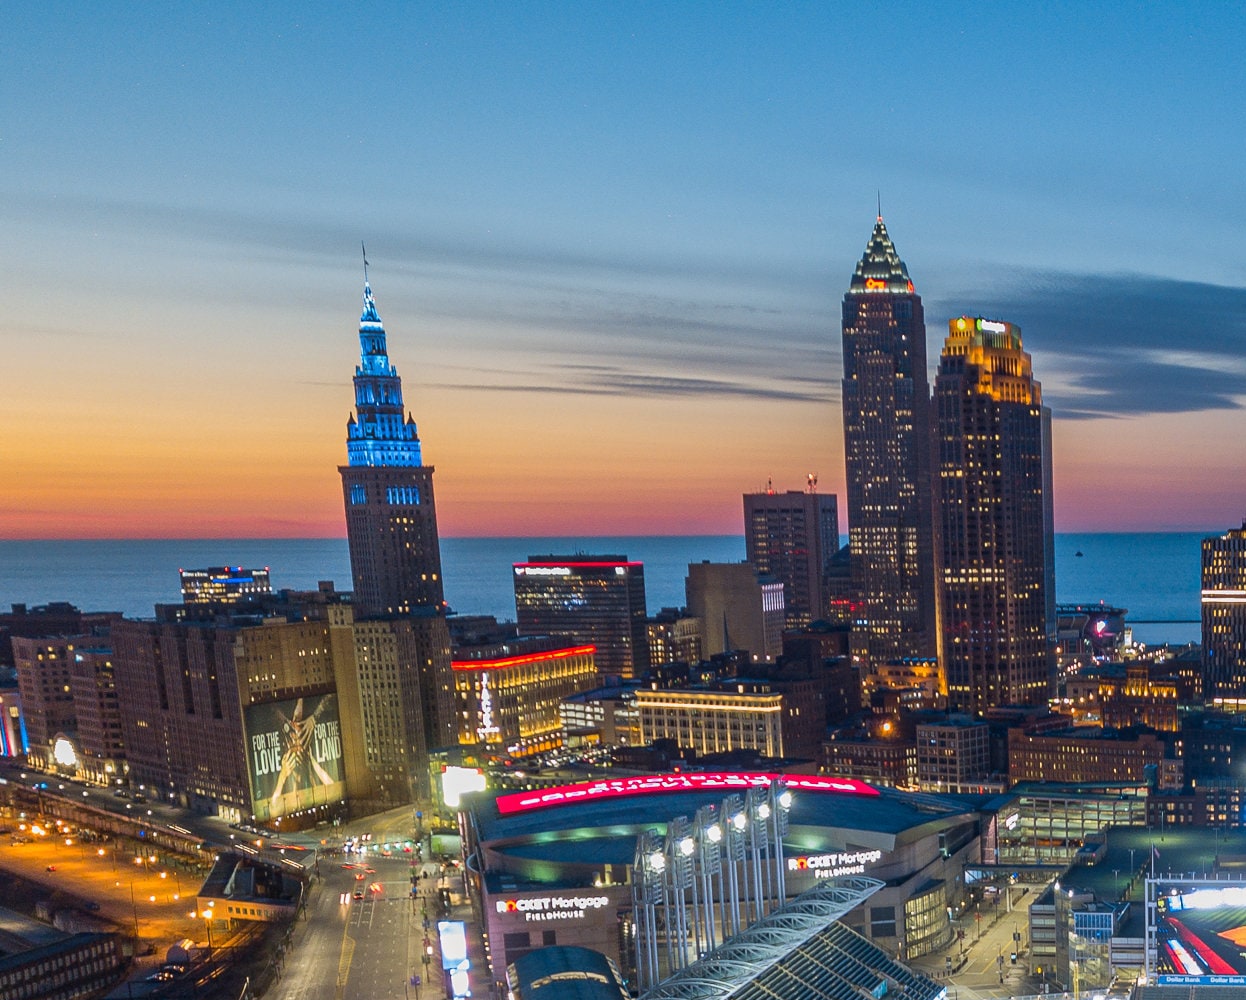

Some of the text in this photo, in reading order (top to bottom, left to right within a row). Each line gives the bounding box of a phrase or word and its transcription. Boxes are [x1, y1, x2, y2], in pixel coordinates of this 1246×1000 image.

[314, 721, 340, 740] FOR THE
[252, 731, 280, 751] FOR THE
[315, 736, 341, 763] LAND
[253, 746, 282, 776] LOVE
[788, 850, 881, 870] ROCKET Mortgage
[496, 896, 609, 912] ROCKET Mortgage
